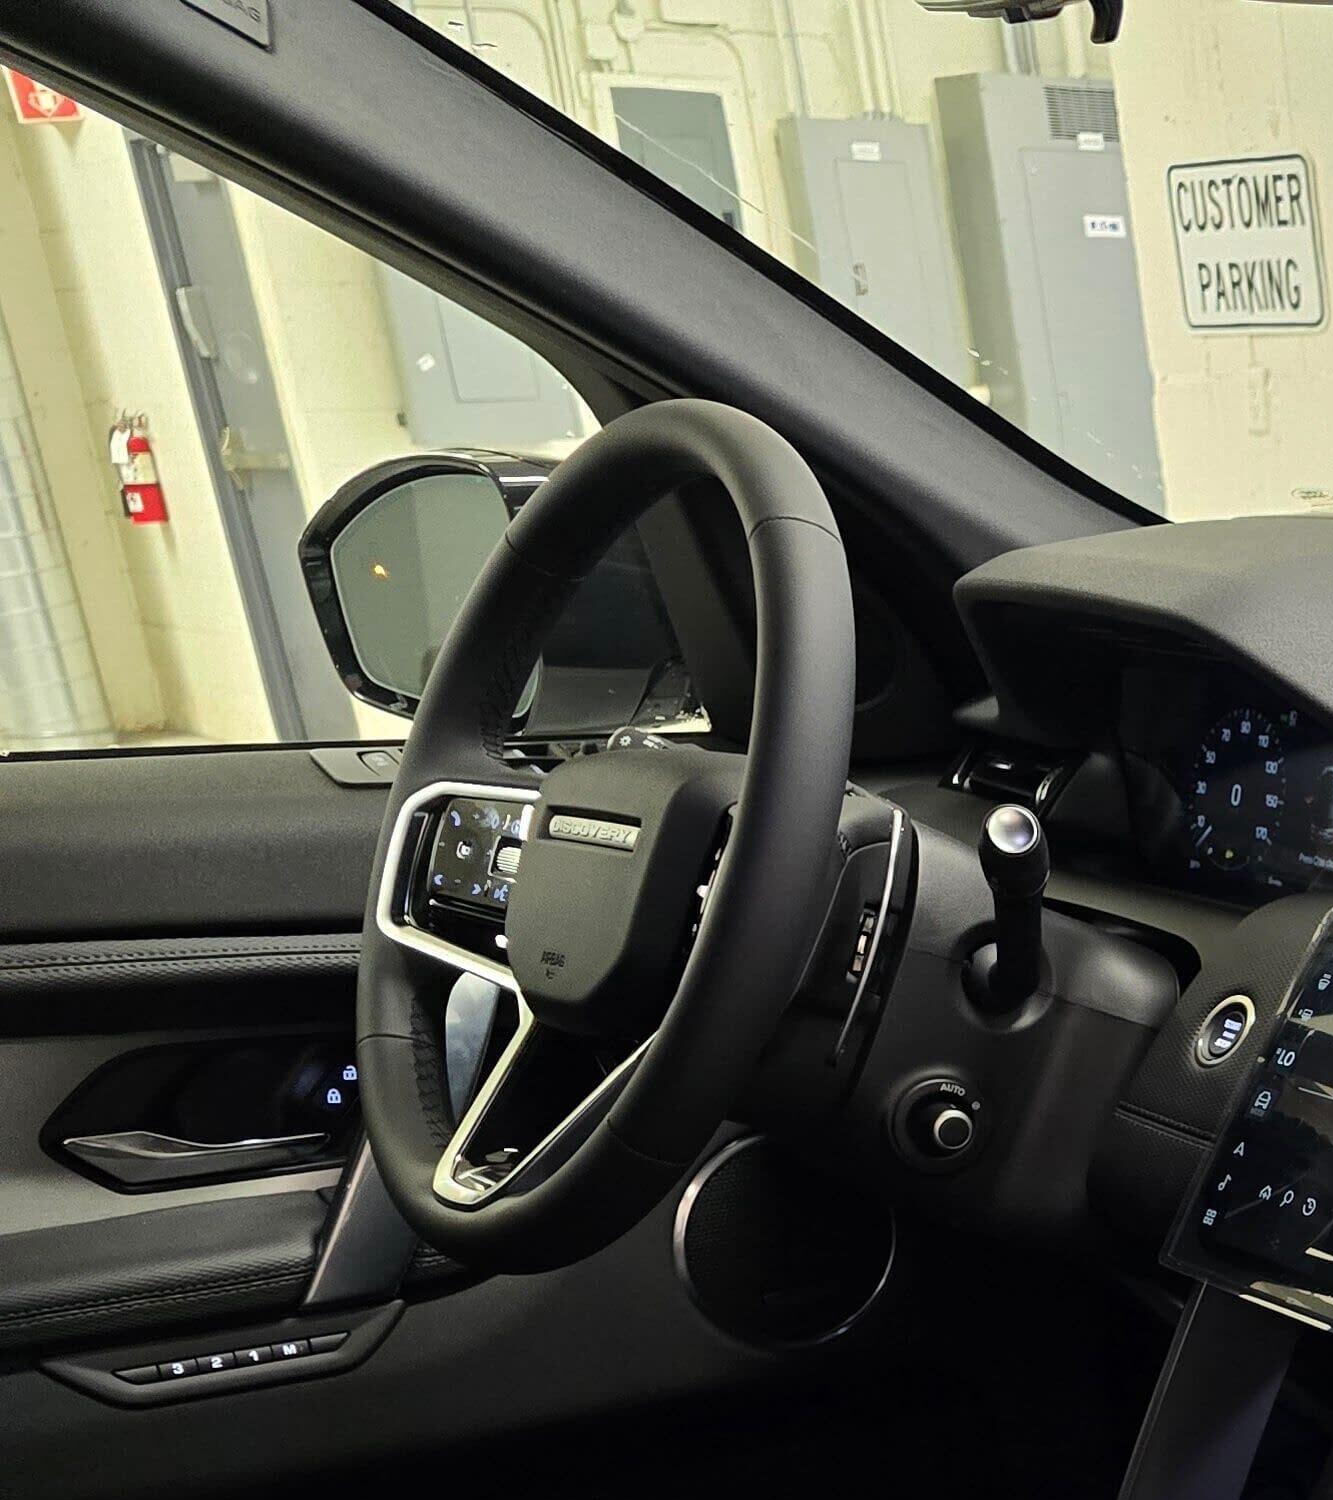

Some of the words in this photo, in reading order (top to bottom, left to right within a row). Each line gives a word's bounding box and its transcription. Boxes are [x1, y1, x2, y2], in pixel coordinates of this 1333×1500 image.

[1176, 174, 1305, 232] CUSTOMER
[1197, 258, 1301, 313] PARKING
[1230, 784, 1242, 807] 0
[552, 817, 632, 844] DISCOVERY
[940, 1082, 966, 1097] AUTO
[171, 1362, 185, 1375] 3
[210, 1357, 223, 1369] 2
[282, 1344, 298, 1356] M
